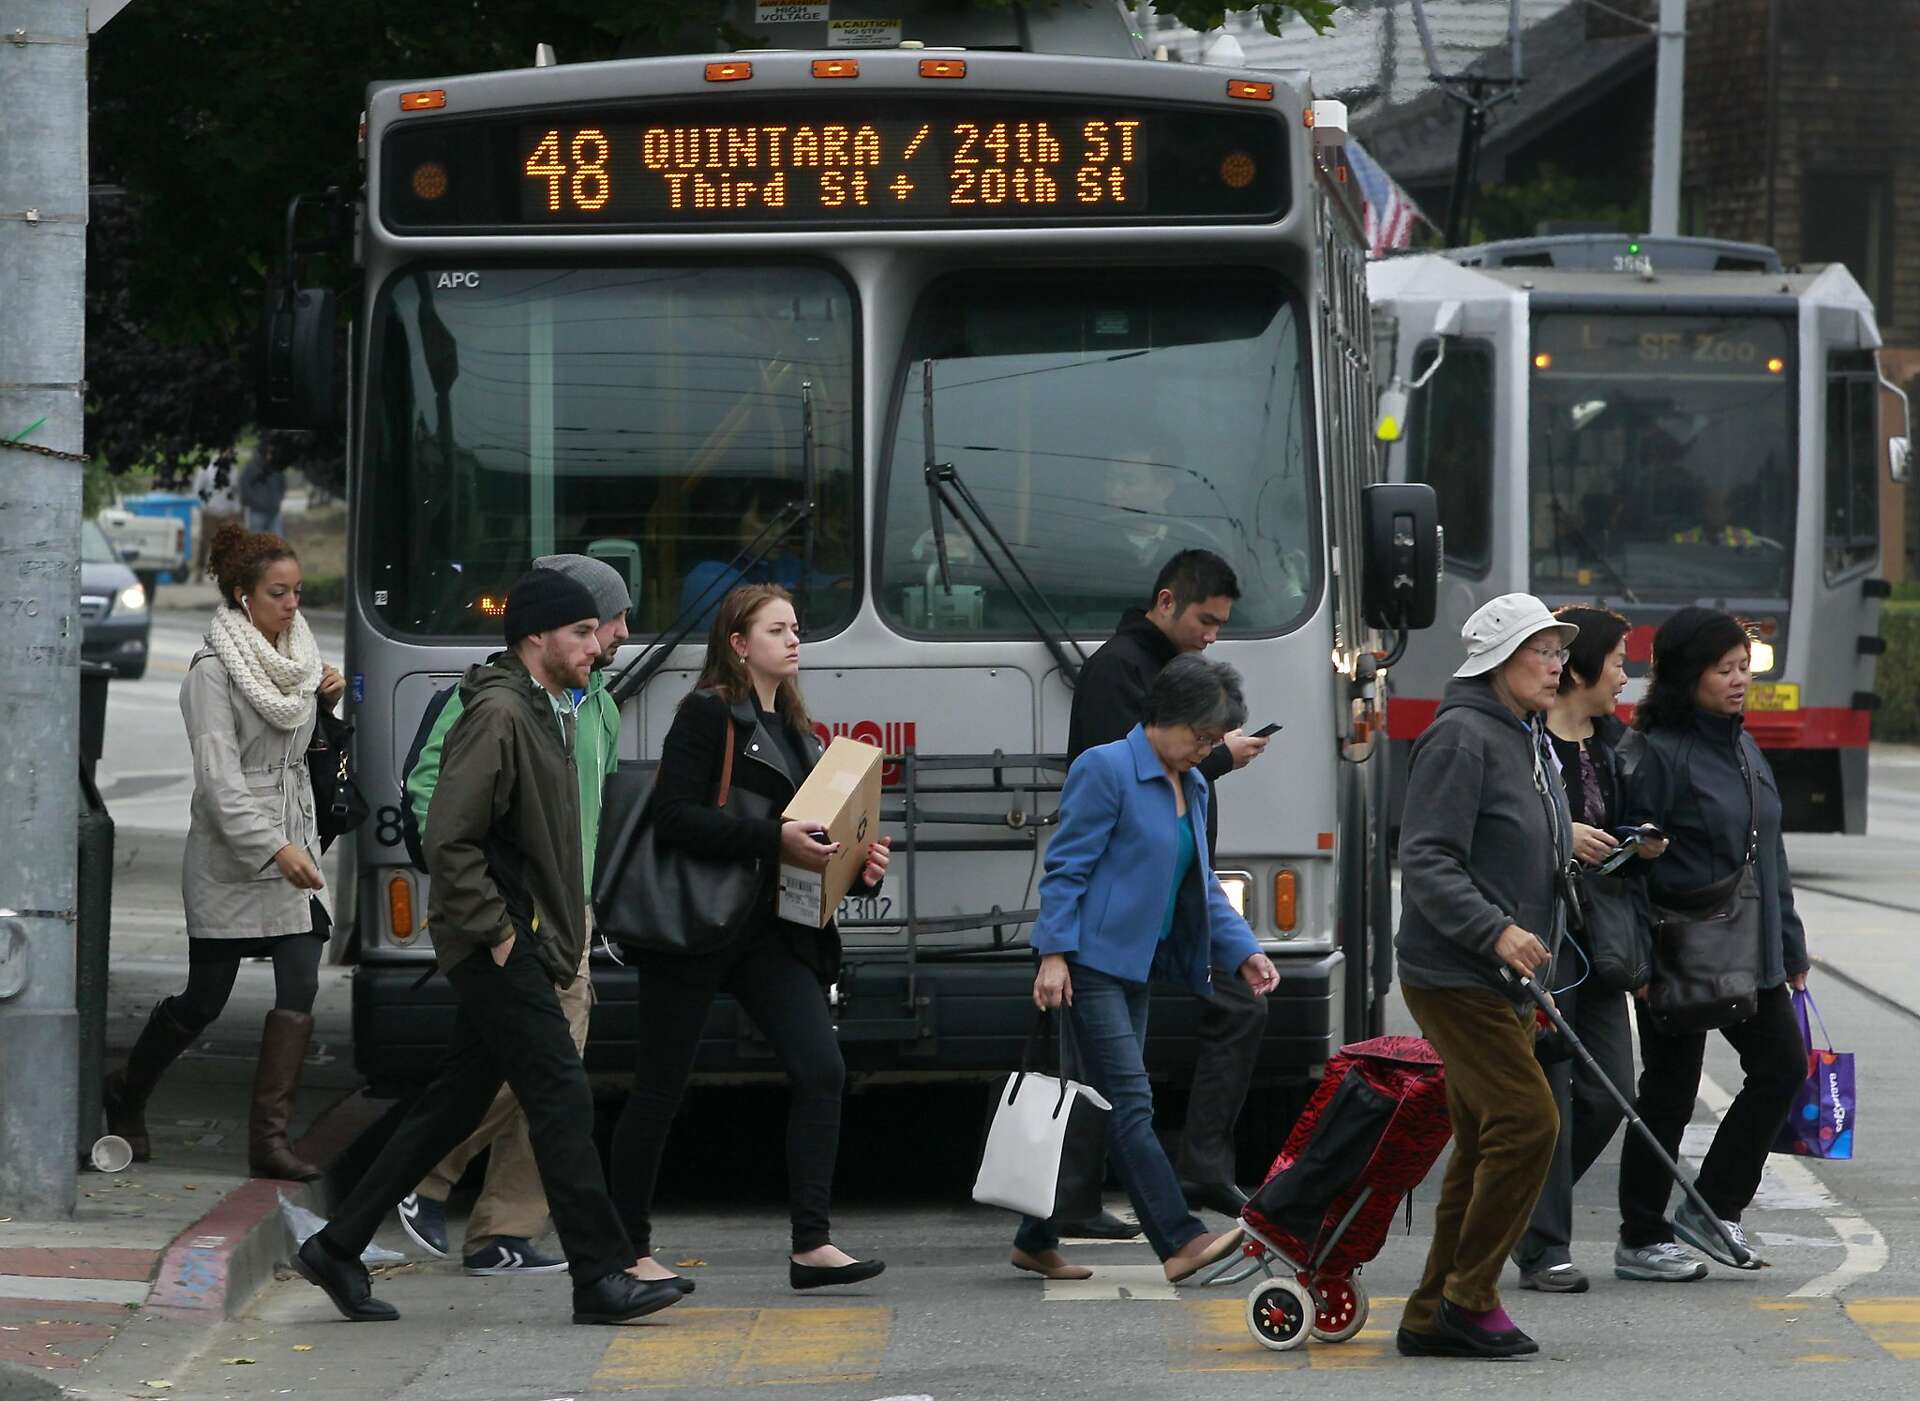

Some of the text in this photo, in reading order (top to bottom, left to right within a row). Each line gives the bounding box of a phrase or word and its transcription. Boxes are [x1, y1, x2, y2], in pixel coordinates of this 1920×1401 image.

[761, 12, 822, 21] VOLTAGE
[840, 20, 898, 28] CAUTION
[643, 126, 881, 169] QUINTARA
[952, 121, 1060, 164] 24th
[1083, 120, 1140, 162] ST
[526, 129, 609, 211] 48
[663, 171, 785, 208] Third
[819, 170, 869, 206] St
[950, 167, 1057, 204] 20th
[1076, 165, 1126, 202] St
[437, 271, 480, 288] APC
[1639, 334, 1681, 361] SF
[1694, 333, 1756, 362] Zoo
[375, 805, 404, 847] 8
